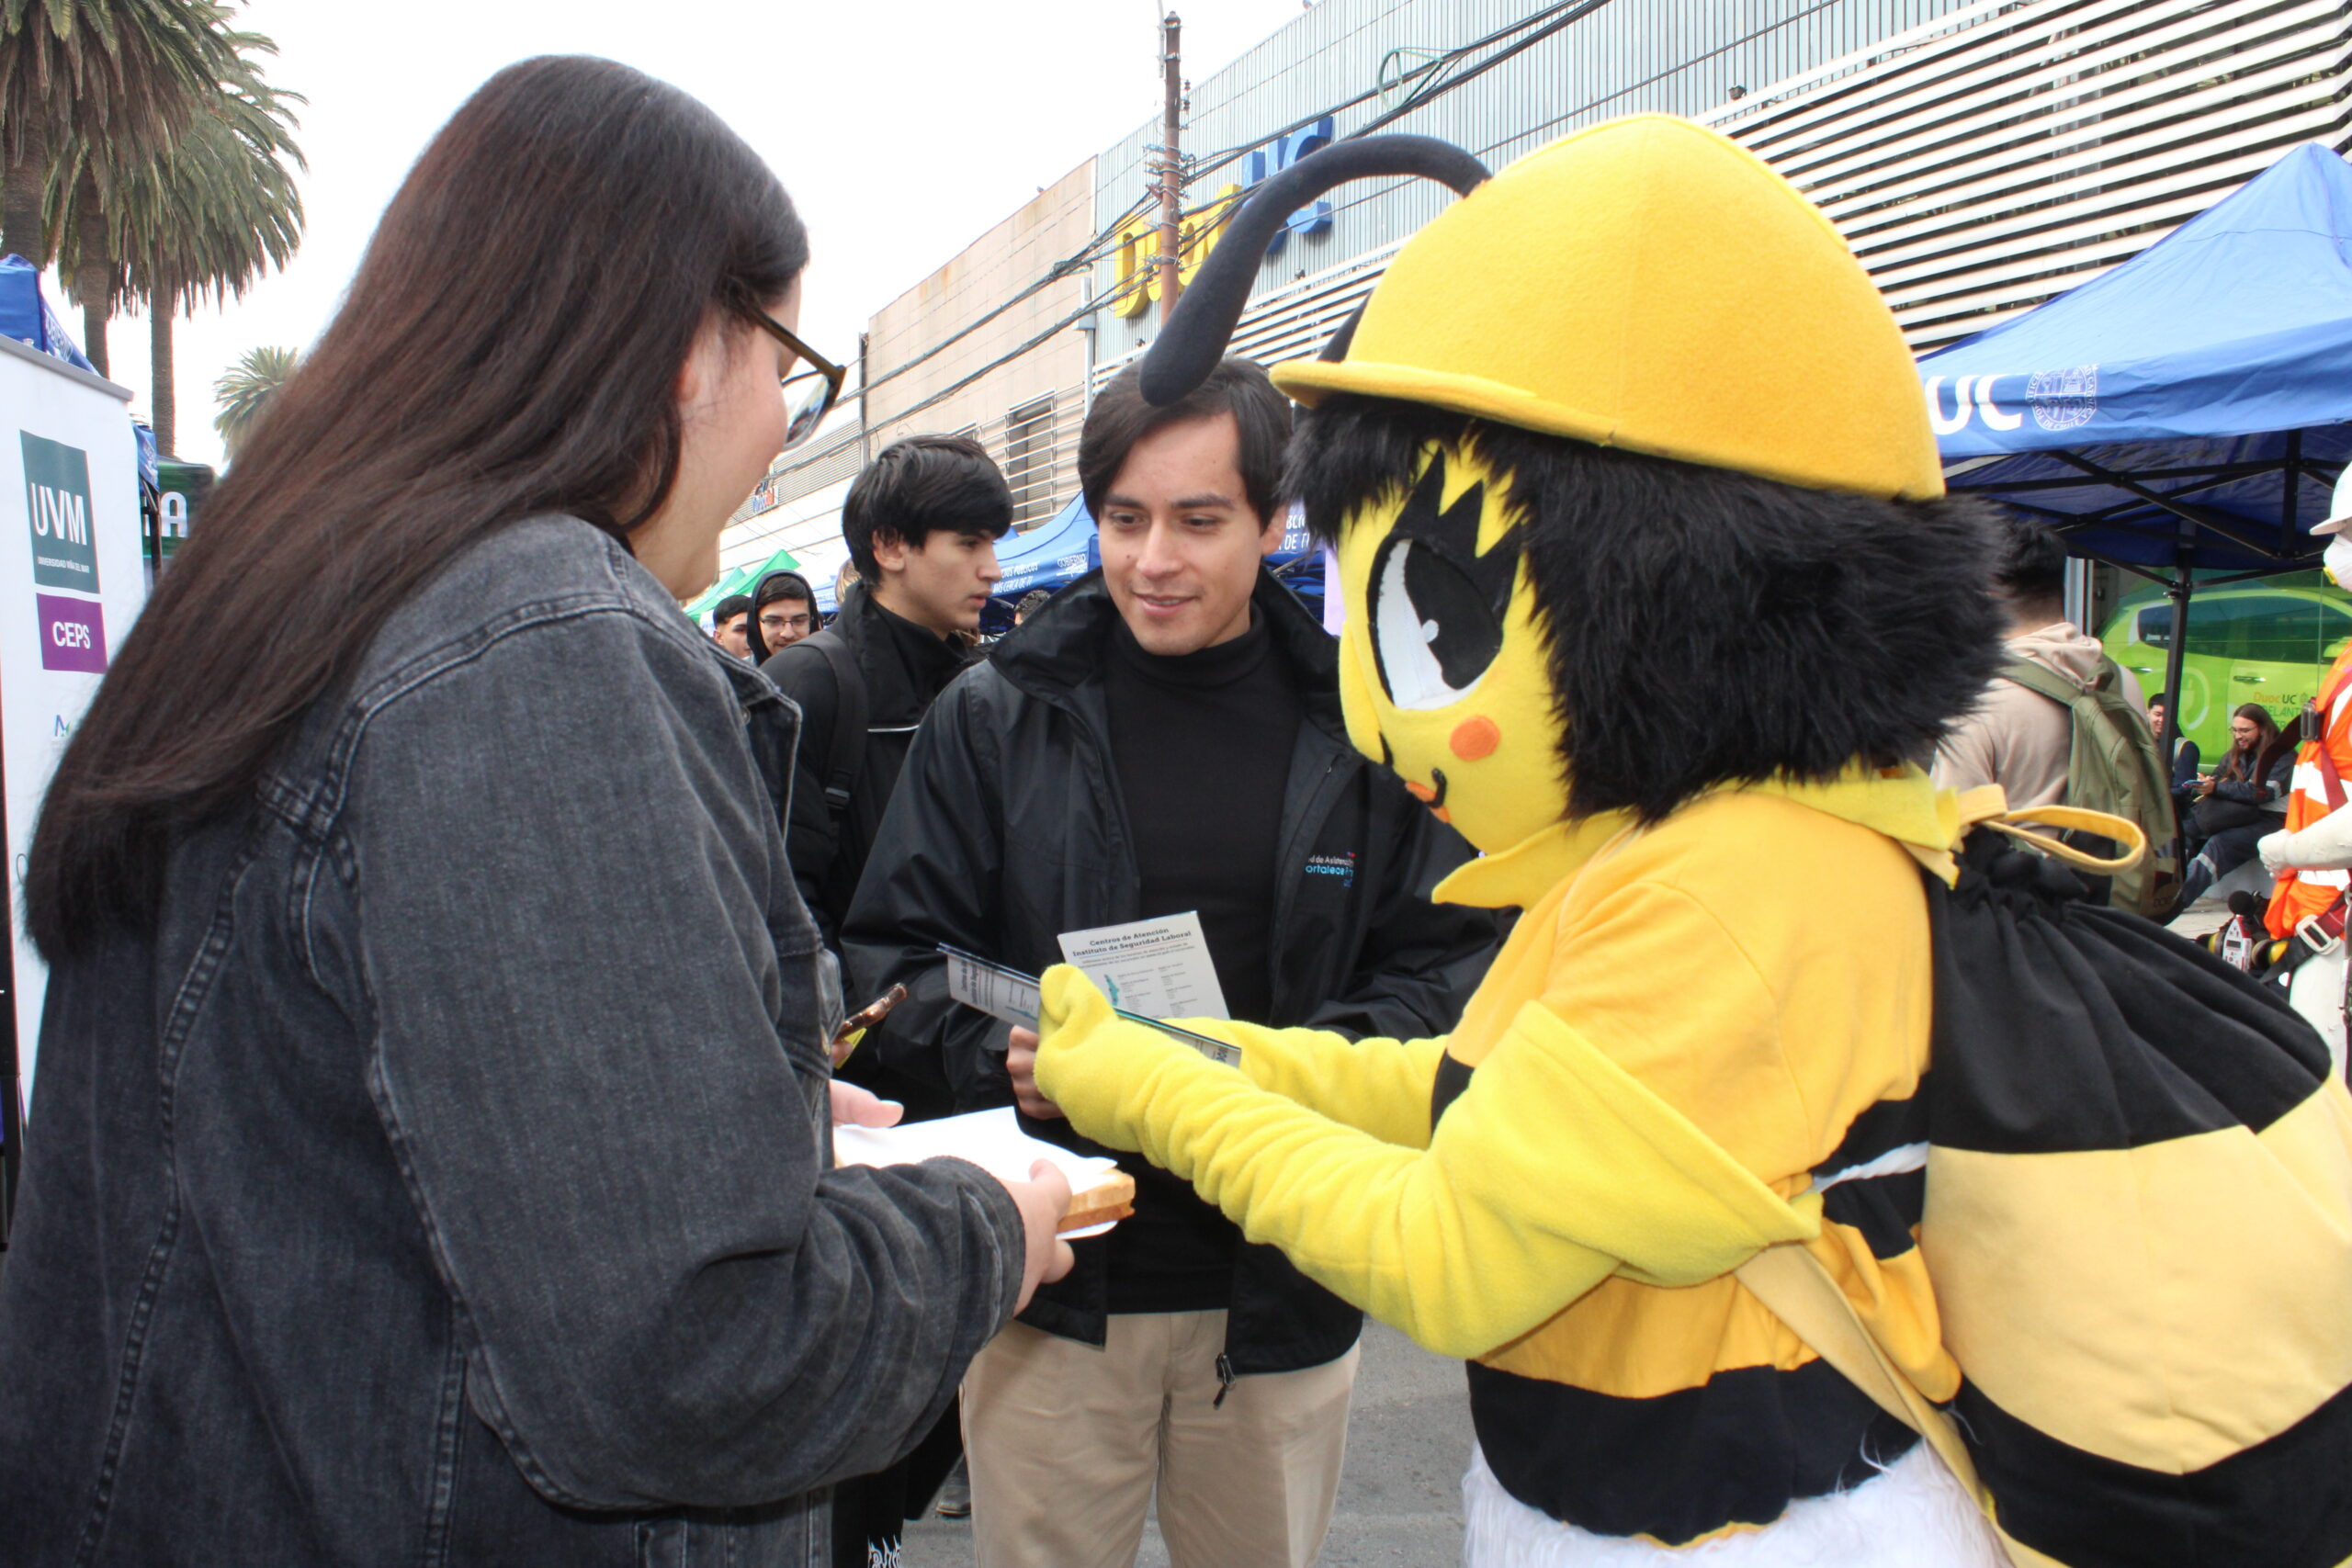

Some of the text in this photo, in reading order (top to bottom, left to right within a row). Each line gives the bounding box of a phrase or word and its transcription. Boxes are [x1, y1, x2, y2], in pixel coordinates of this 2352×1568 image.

[1925, 373, 2022, 435] UC
[31, 482, 88, 546] UVM
[1284, 534, 1297, 550] DE
[52, 621, 92, 649] CEPS
[2282, 694, 2297, 705] UC
[1090, 927, 1170, 946] Centros de Atención
